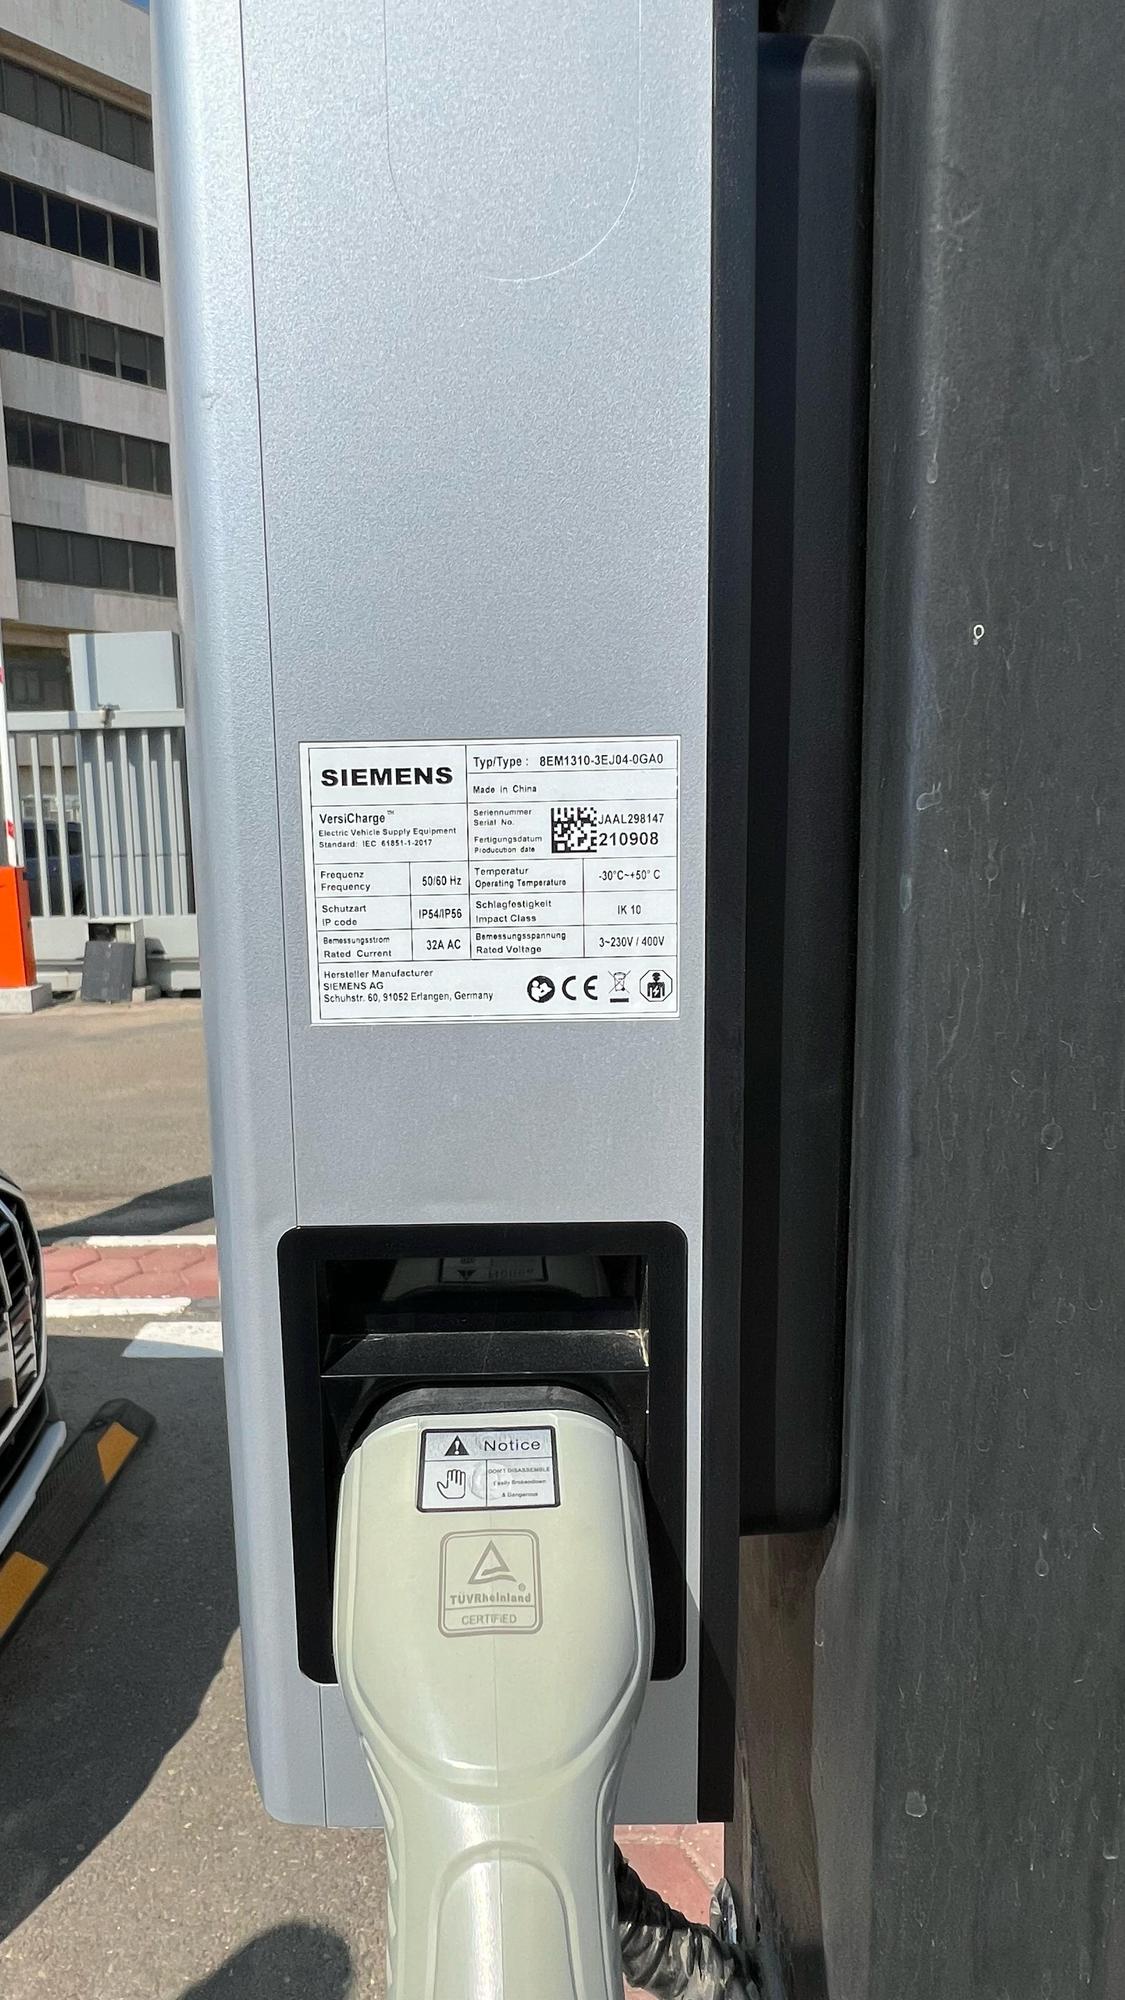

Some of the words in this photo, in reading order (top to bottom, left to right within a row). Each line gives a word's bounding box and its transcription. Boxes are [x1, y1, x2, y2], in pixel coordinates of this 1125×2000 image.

[473, 756, 522, 770] Typ/Type
[539, 753, 664, 767] 8EM1310-3EJ04-0GA0
[321, 766, 453, 787] SIEMENS
[473, 785, 495, 794] Made
[500, 785, 508, 793] in
[512, 784, 537, 793] China
[598, 813, 665, 825] JAAL298147
[318, 829, 349, 837] Electric
[350, 828, 381, 837] Vehicle
[382, 828, 411, 837] Supply
[413, 827, 457, 836] Equipment
[381, 838, 433, 847] 61851-1-2017
[474, 836, 543, 844] Fertigungsdatum
[598, 831, 659, 846] 210908
[519, 845, 536, 853] date
[320, 870, 365, 879] Frequenz
[474, 867, 529, 877] Temperatur
[422, 875, 447, 887] 50/60
[449, 875, 462, 886] Hz
[474, 879, 515, 889] Operating
[517, 878, 567, 888] Temperature
[320, 882, 371, 891] Frequency
[321, 904, 367, 913] Schutzart
[475, 900, 552, 910] Schlagfestigkeit
[617, 904, 627, 915] IK
[630, 904, 642, 915] 10
[334, 918, 358, 926] code
[475, 915, 508, 924] Impact
[510, 914, 537, 923] Class
[323, 936, 390, 945] Bemessungsstrom
[475, 932, 567, 941] Bemessungsspannung
[599, 936, 634, 948] 3~230V
[641, 935, 665, 947] 400V
[426, 939, 445, 950] 32A
[447, 939, 461, 949] AC
[476, 946, 504, 954] Rated
[505, 945, 542, 954] Voltage
[324, 950, 351, 958] Rated
[356, 949, 392, 958] Current
[324, 970, 369, 979] Hersteller
[371, 969, 434, 977] Manufacturer
[323, 982, 367, 991] SIEMENS
[369, 981, 384, 990] AG
[323, 994, 363, 1003] Schuhstr.
[367, 993, 381, 1003] 60,
[382, 992, 408, 1001] 91052
[410, 992, 452, 1002] Erlangen,
[454, 991, 494, 1001] Germany
[484, 1439, 541, 1452] Notice
[461, 1614, 517, 1625] CERTIFIED
